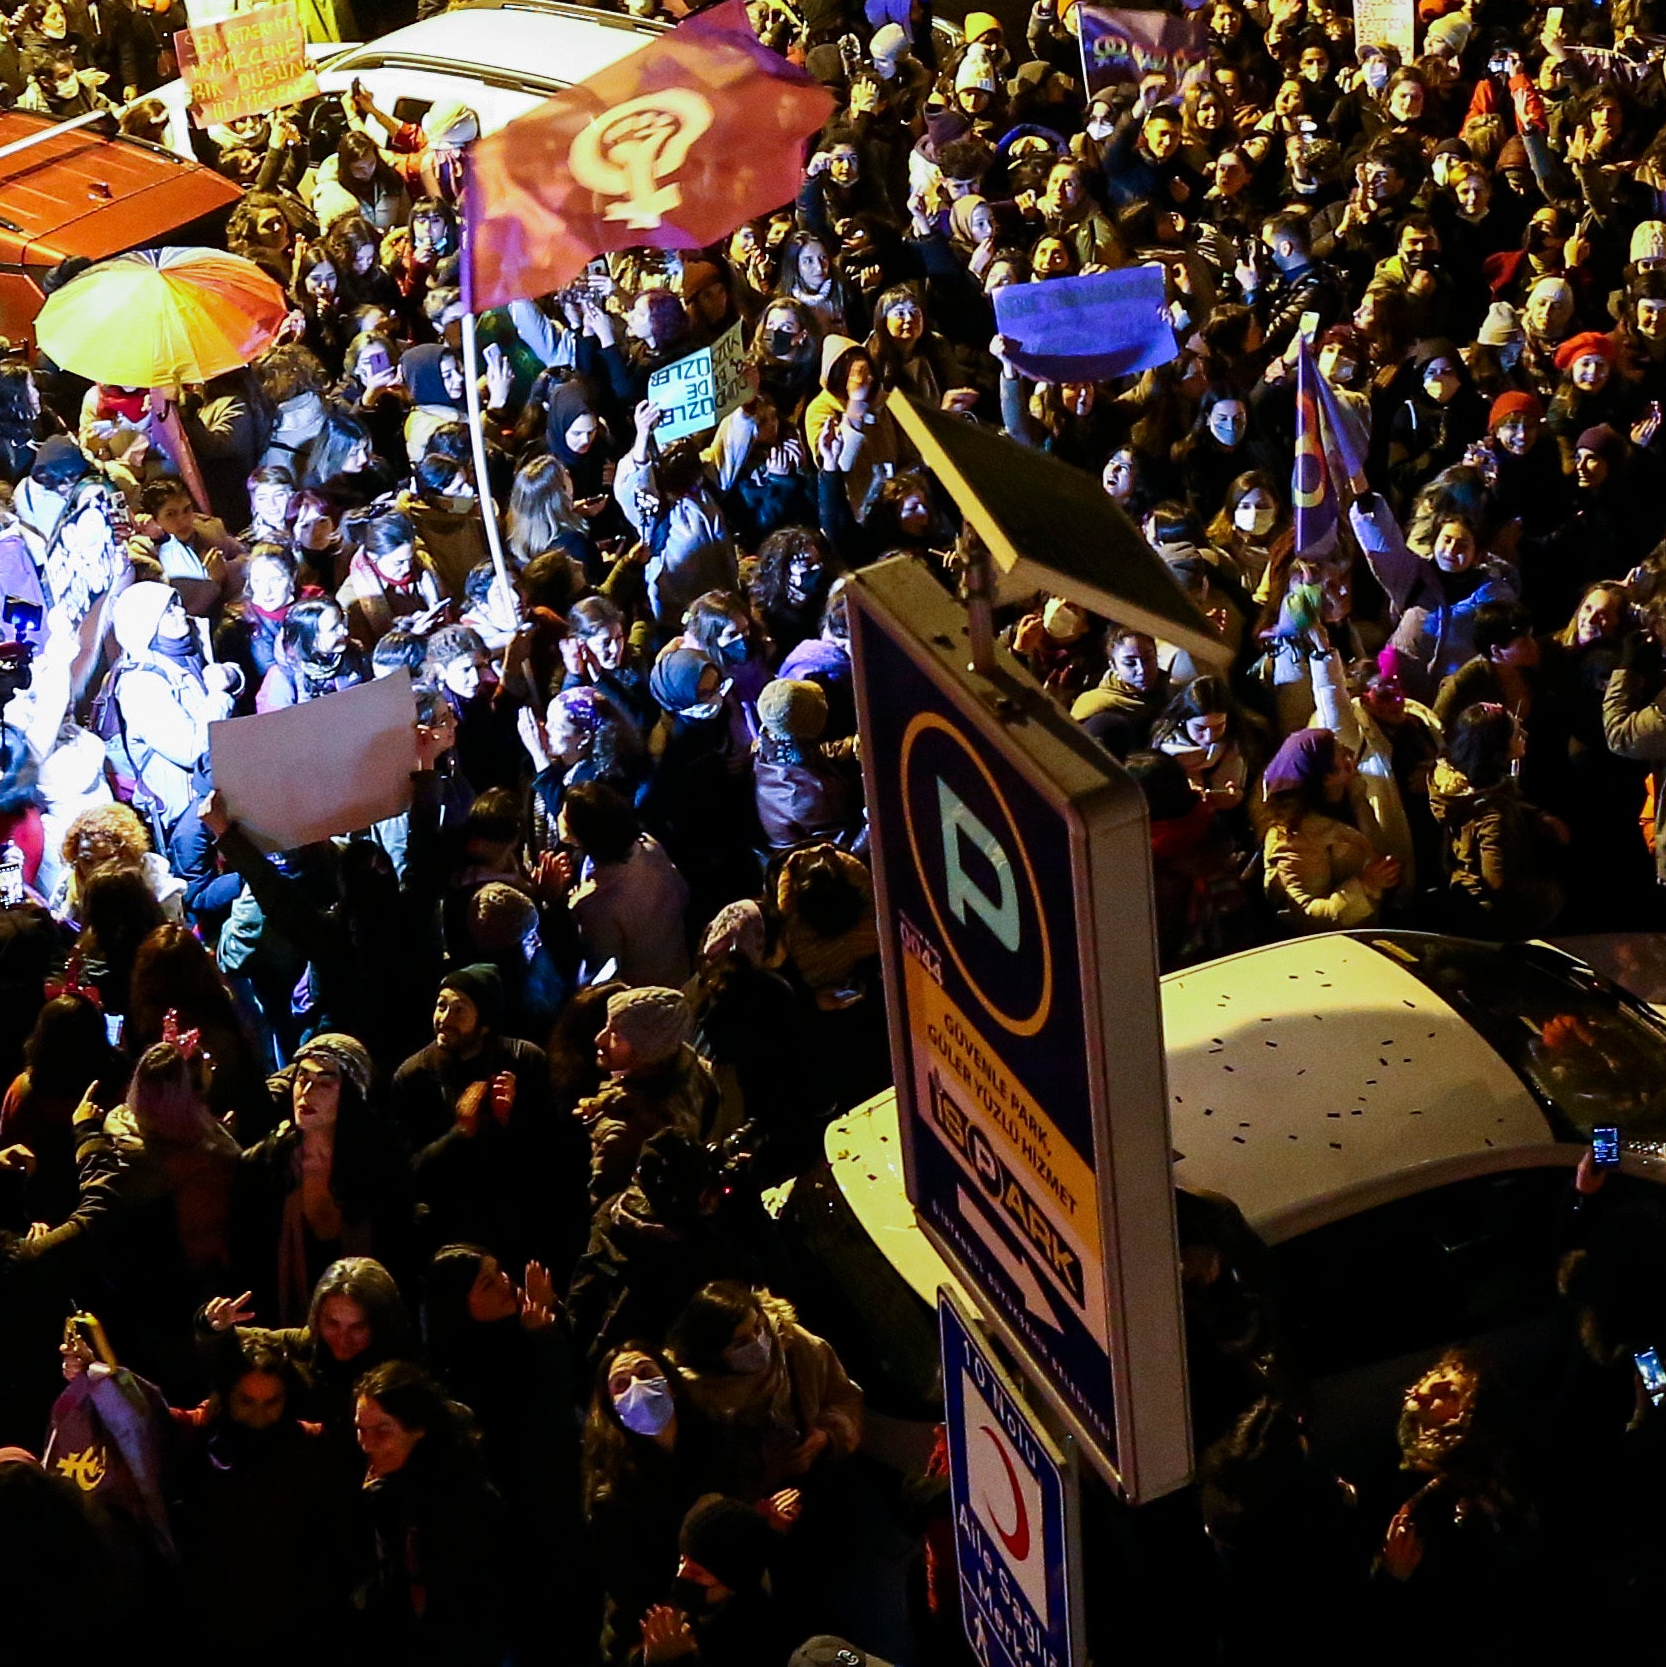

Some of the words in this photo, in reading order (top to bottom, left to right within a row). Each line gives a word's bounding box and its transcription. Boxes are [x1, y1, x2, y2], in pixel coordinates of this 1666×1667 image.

[936, 775, 1022, 954] P
[927, 1023, 974, 1087] GÜLER
[974, 1082, 1020, 1146] YÜZLÜ
[1022, 1134, 1079, 1216] HİZMET
[944, 1013, 1008, 1096] GÜVENLE
[1011, 1093, 1053, 1157] PARK,
[963, 1338, 986, 1389] 10
[992, 1382, 1037, 1470] Nolu
[959, 1503, 993, 1575] Aile
